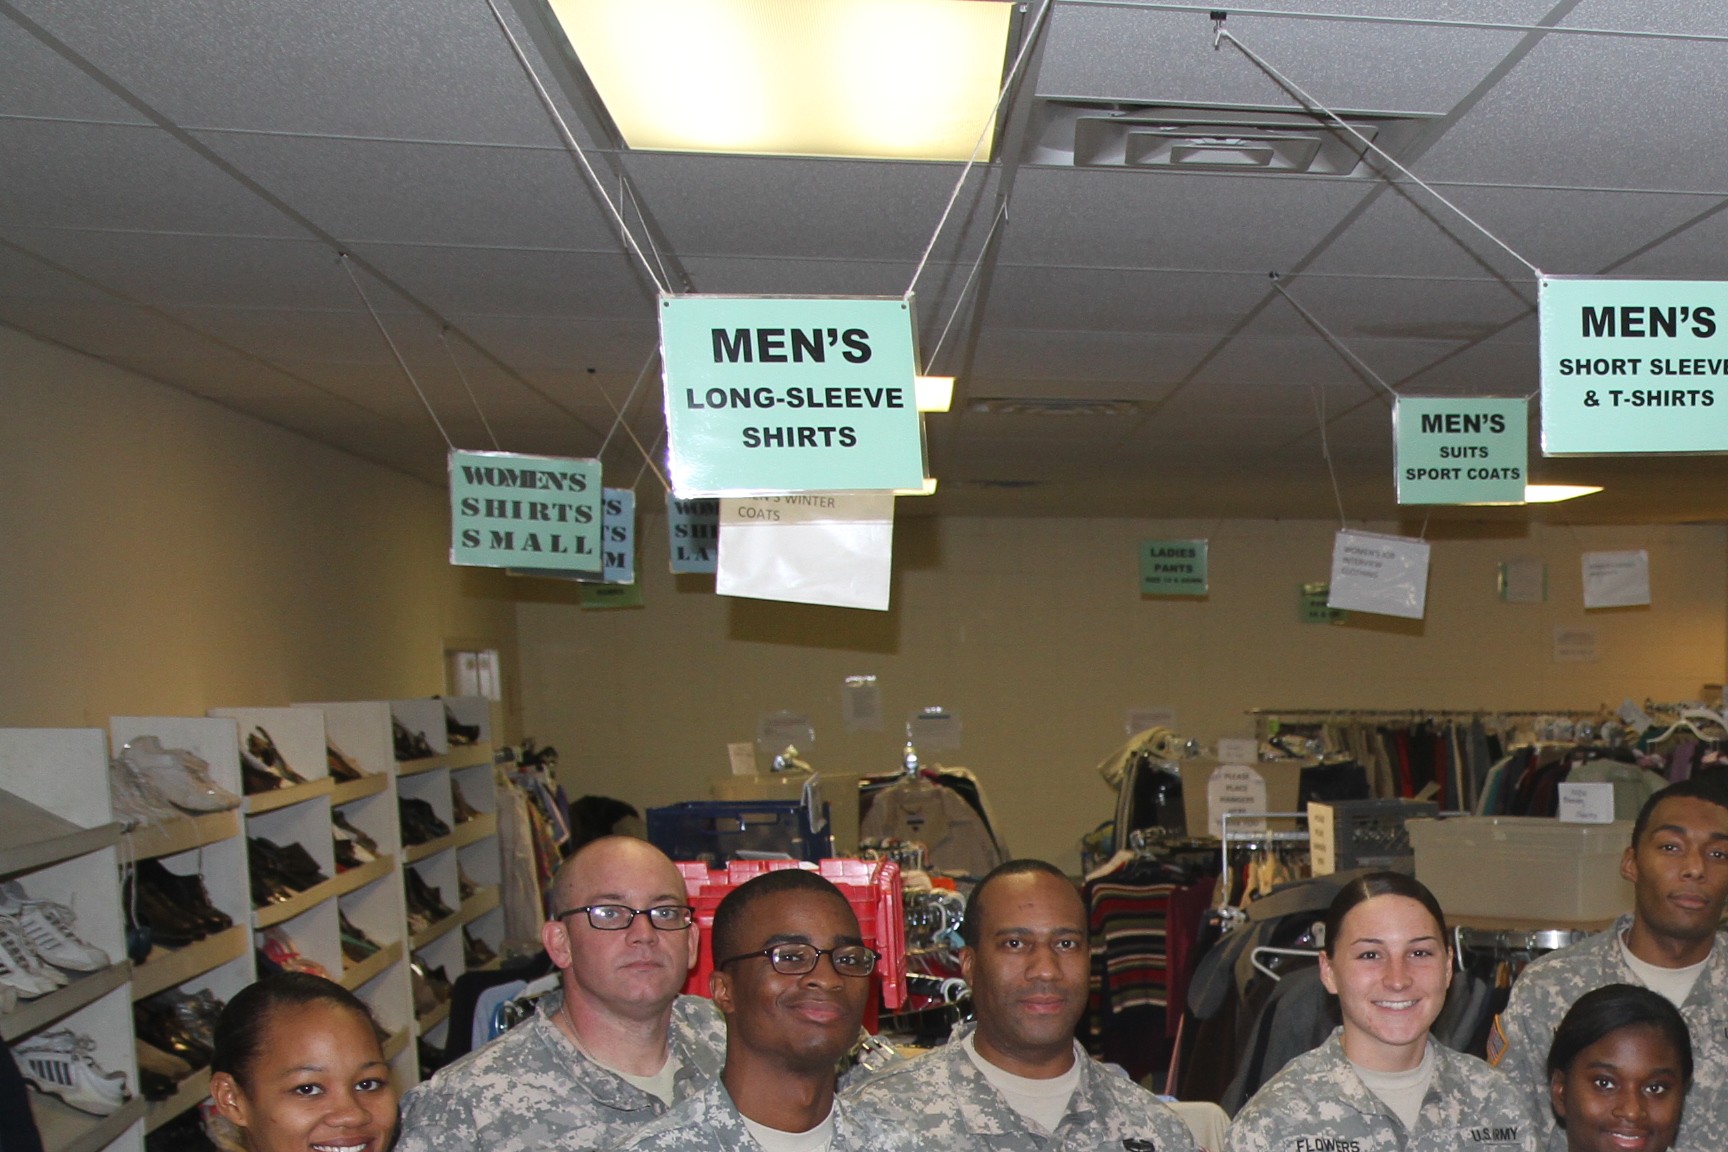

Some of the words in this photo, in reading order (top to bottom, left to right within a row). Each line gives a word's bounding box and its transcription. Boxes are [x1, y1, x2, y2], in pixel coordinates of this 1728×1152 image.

[1580, 306, 1717, 339] MEN'S
[712, 328, 872, 364] MEN'S
[1558, 358, 1641, 377] SHORT
[686, 387, 904, 410] LONG-SLEEVE
[1583, 391, 1600, 408] &
[1610, 390, 1715, 408] T-SHIRTS
[1420, 413, 1506, 435] MEN'S
[742, 426, 857, 448] SHIRTS
[1439, 446, 1489, 460] SUITS
[461, 465, 587, 492] WOMEN'S
[1405, 468, 1462, 481] SPORT
[1466, 468, 1521, 481] COATS
[461, 497, 593, 525] SHIRTS
[738, 506, 781, 522] COATS
[461, 528, 593, 555] SMALL
[1150, 547, 1196, 559] LADIES
[1154, 564, 1193, 574] PANTS
